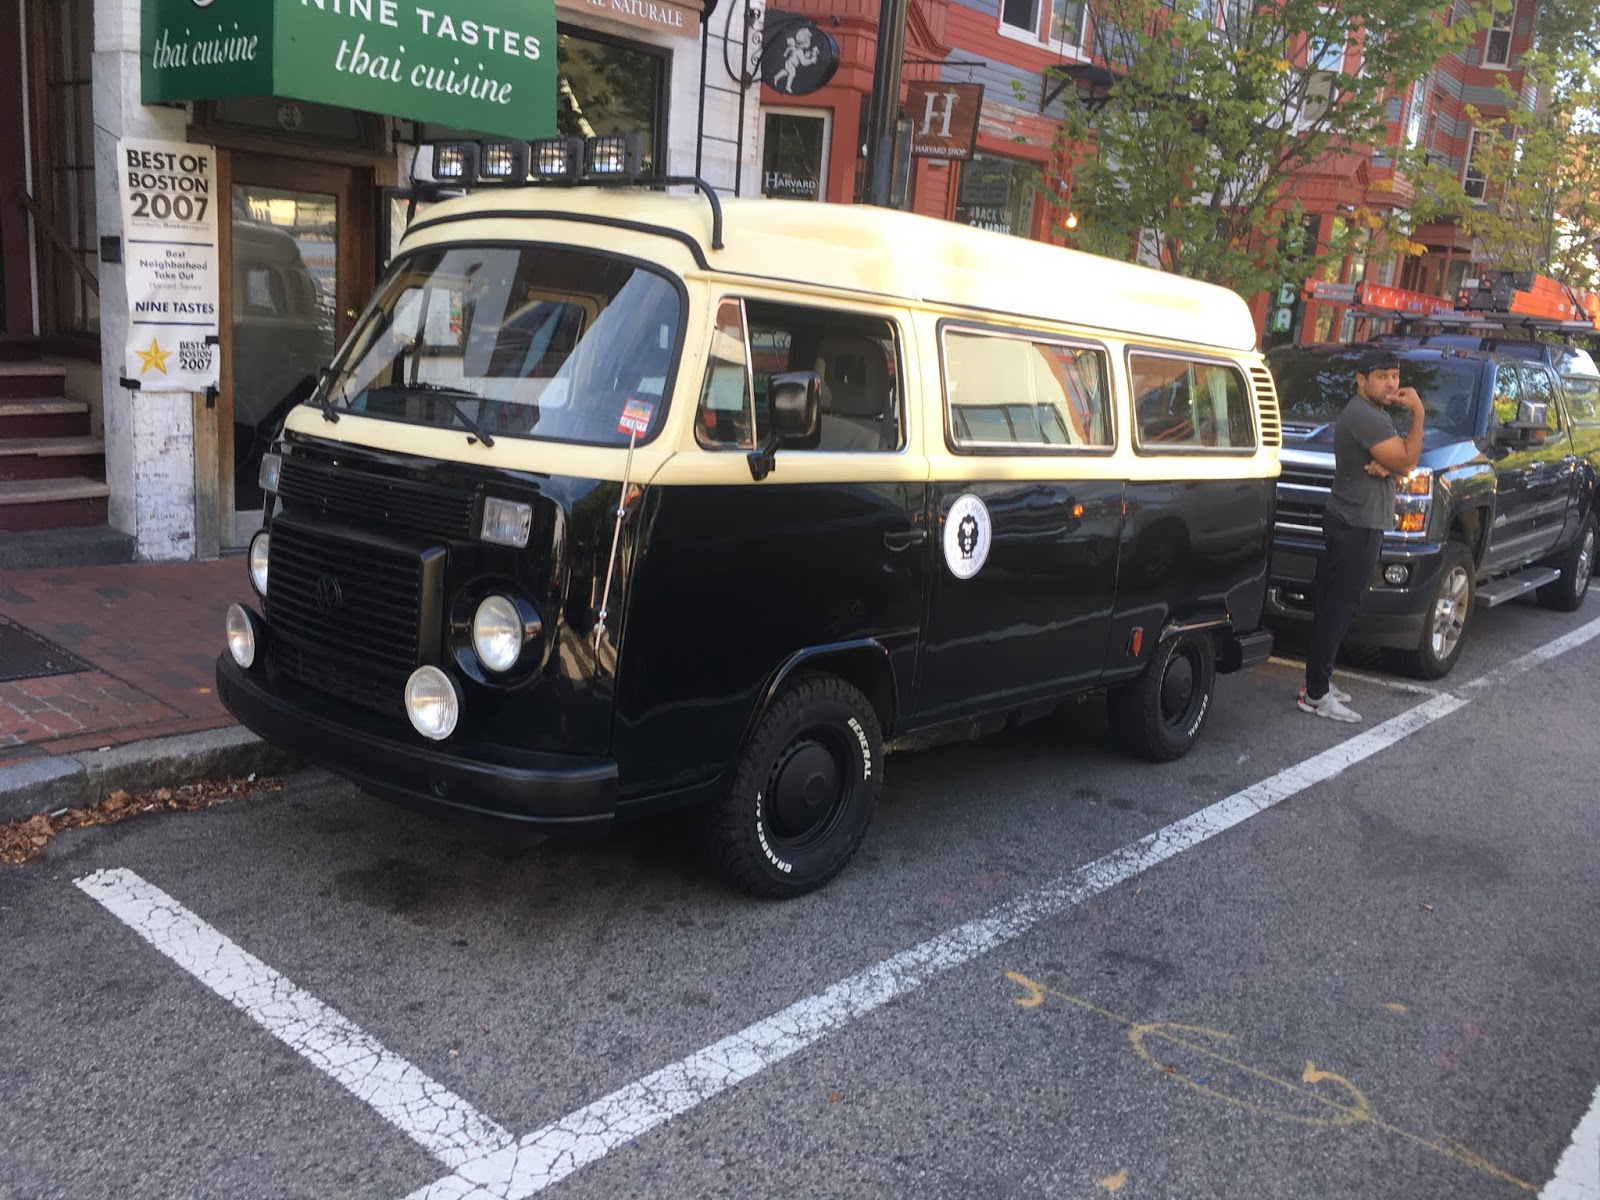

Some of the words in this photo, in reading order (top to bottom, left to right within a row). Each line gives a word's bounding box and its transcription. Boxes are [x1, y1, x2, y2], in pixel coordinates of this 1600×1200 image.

[611, 0, 683, 27] NATURALE
[415, 7, 541, 60] TASTES
[152, 28, 190, 69] thai
[192, 22, 258, 66] cuisine
[335, 33, 406, 83] thai
[410, 57, 513, 105] cuisine
[918, 92, 959, 138] H
[126, 149, 176, 171] BEST
[179, 154, 208, 173] OF
[915, 144, 947, 155] HARVARD
[947, 147, 967, 157] SHOP
[128, 172, 209, 193] BOSTON
[764, 171, 817, 190] HARVARD
[130, 192, 208, 221] 2007
[165, 249, 185, 258] Best
[139, 259, 208, 271] Neighborhood
[153, 271, 176, 280] Take
[178, 273, 194, 281] Out
[135, 302, 169, 313] NINE
[173, 302, 215, 314] TASTES
[179, 341, 200, 350] BEST
[179, 349, 212, 359] BOSTON
[179, 358, 212, 370] 2007
[847, 717, 872, 780] GENERAL
[756, 821, 792, 874] GRABBER
